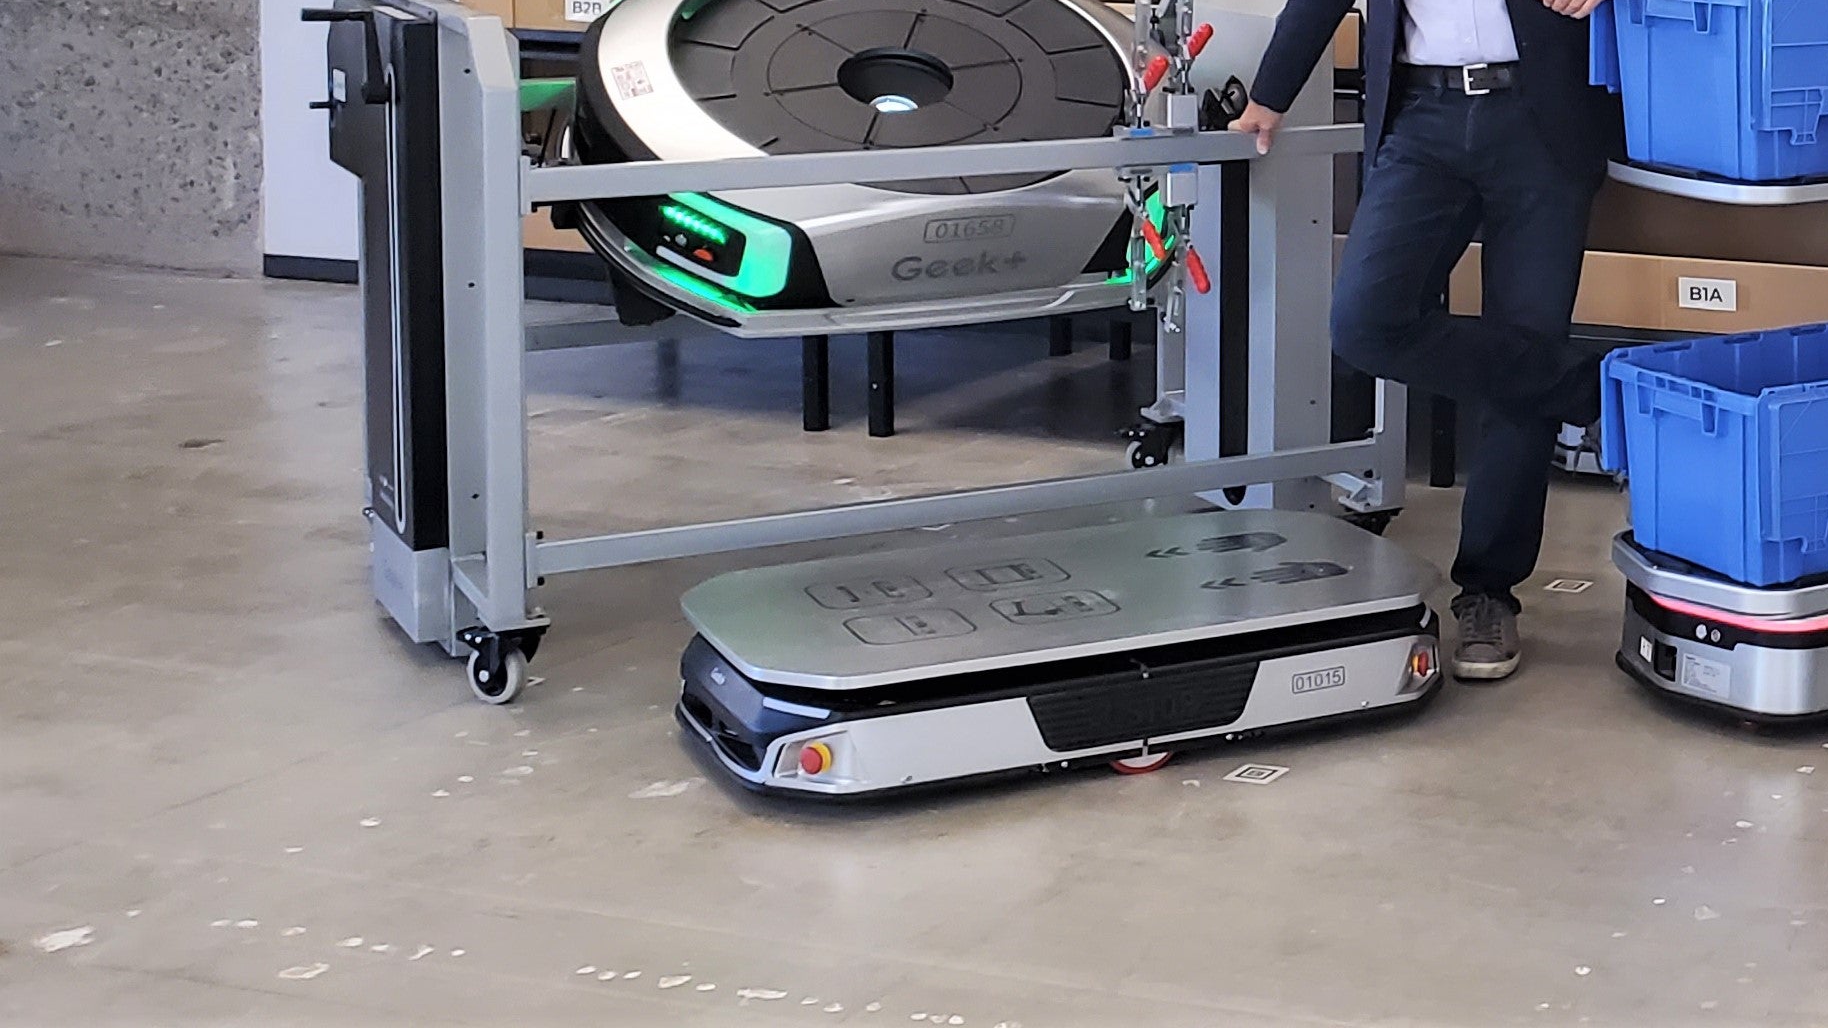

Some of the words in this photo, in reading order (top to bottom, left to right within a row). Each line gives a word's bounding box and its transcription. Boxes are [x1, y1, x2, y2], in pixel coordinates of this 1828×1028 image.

[891, 252, 1027, 281] Geek+
[1690, 287, 1722, 302] B1A
[1296, 670, 1341, 690] 01015
